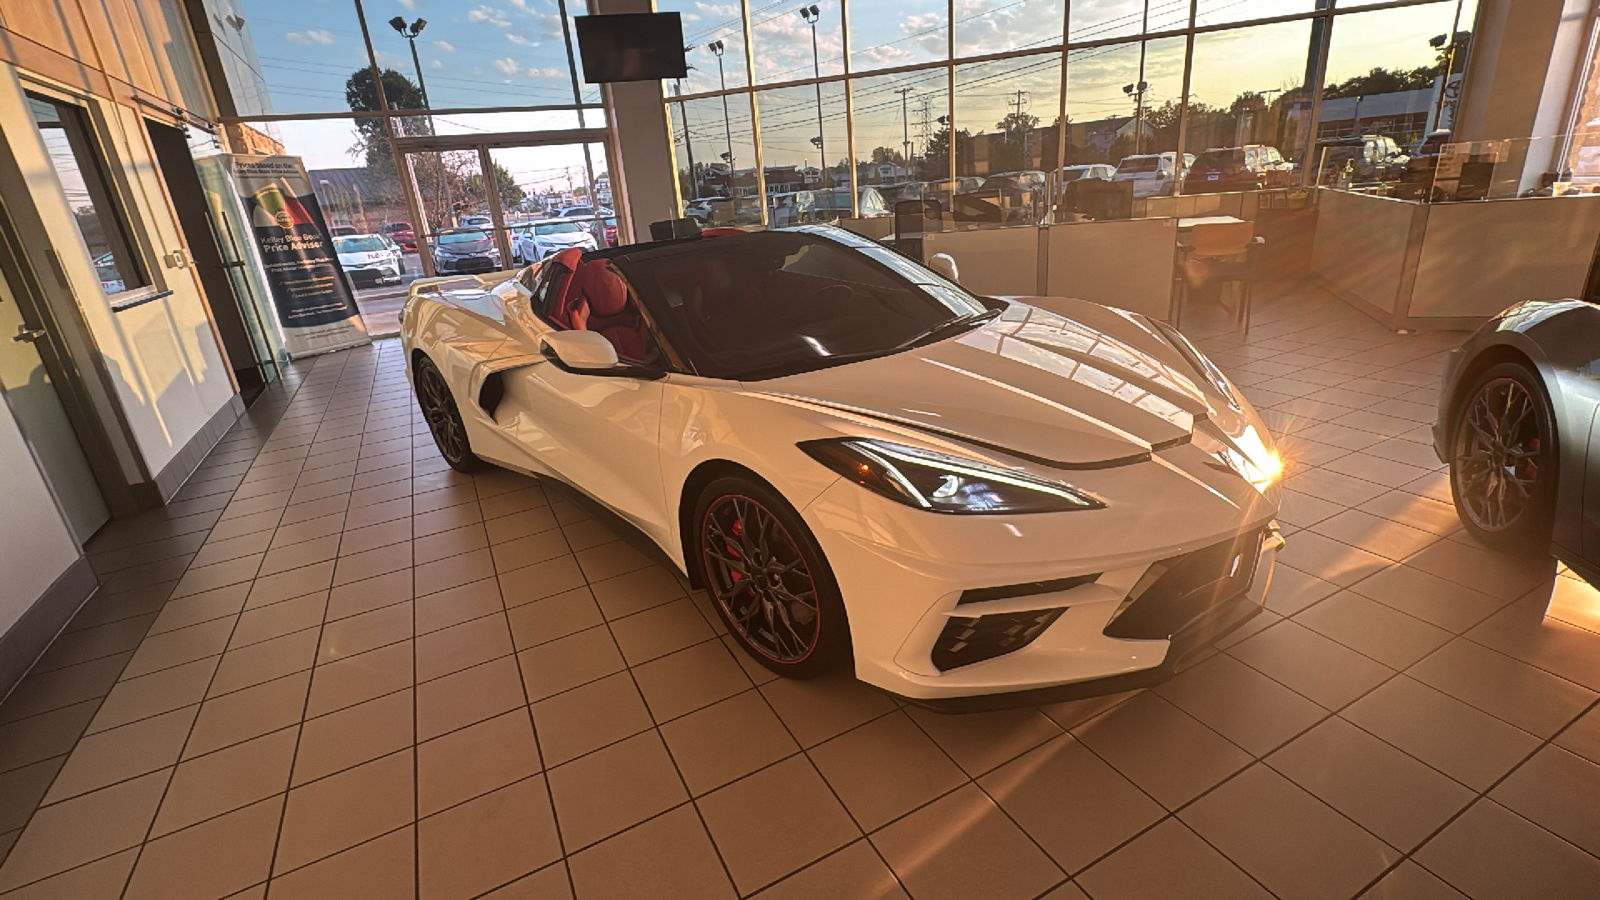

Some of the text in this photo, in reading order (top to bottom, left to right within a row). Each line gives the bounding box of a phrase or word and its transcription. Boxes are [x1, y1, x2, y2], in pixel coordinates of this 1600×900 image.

[261, 236, 284, 244] Kelley
[285, 234, 302, 242] Blue
[263, 241, 323, 252] Price Advisor
